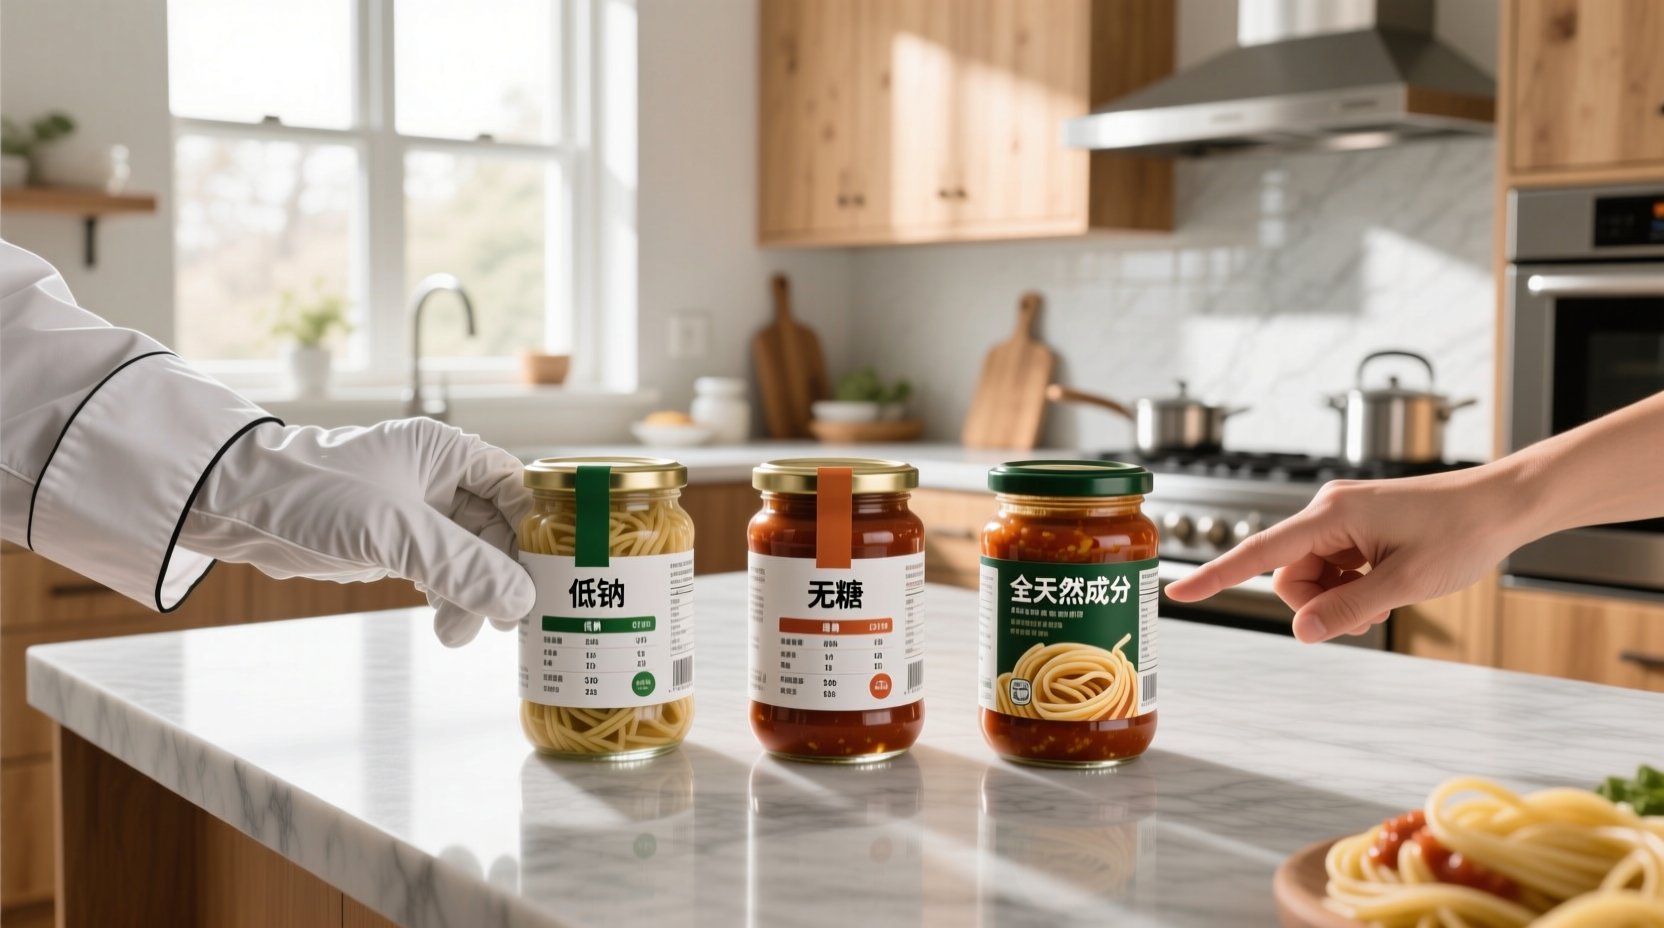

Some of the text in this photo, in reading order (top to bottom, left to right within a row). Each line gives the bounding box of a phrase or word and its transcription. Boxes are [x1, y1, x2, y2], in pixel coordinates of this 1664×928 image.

[569, 578, 625, 608] 低钠
[808, 579, 864, 609] 无糖
[1009, 574, 1131, 605] 全天然成分
